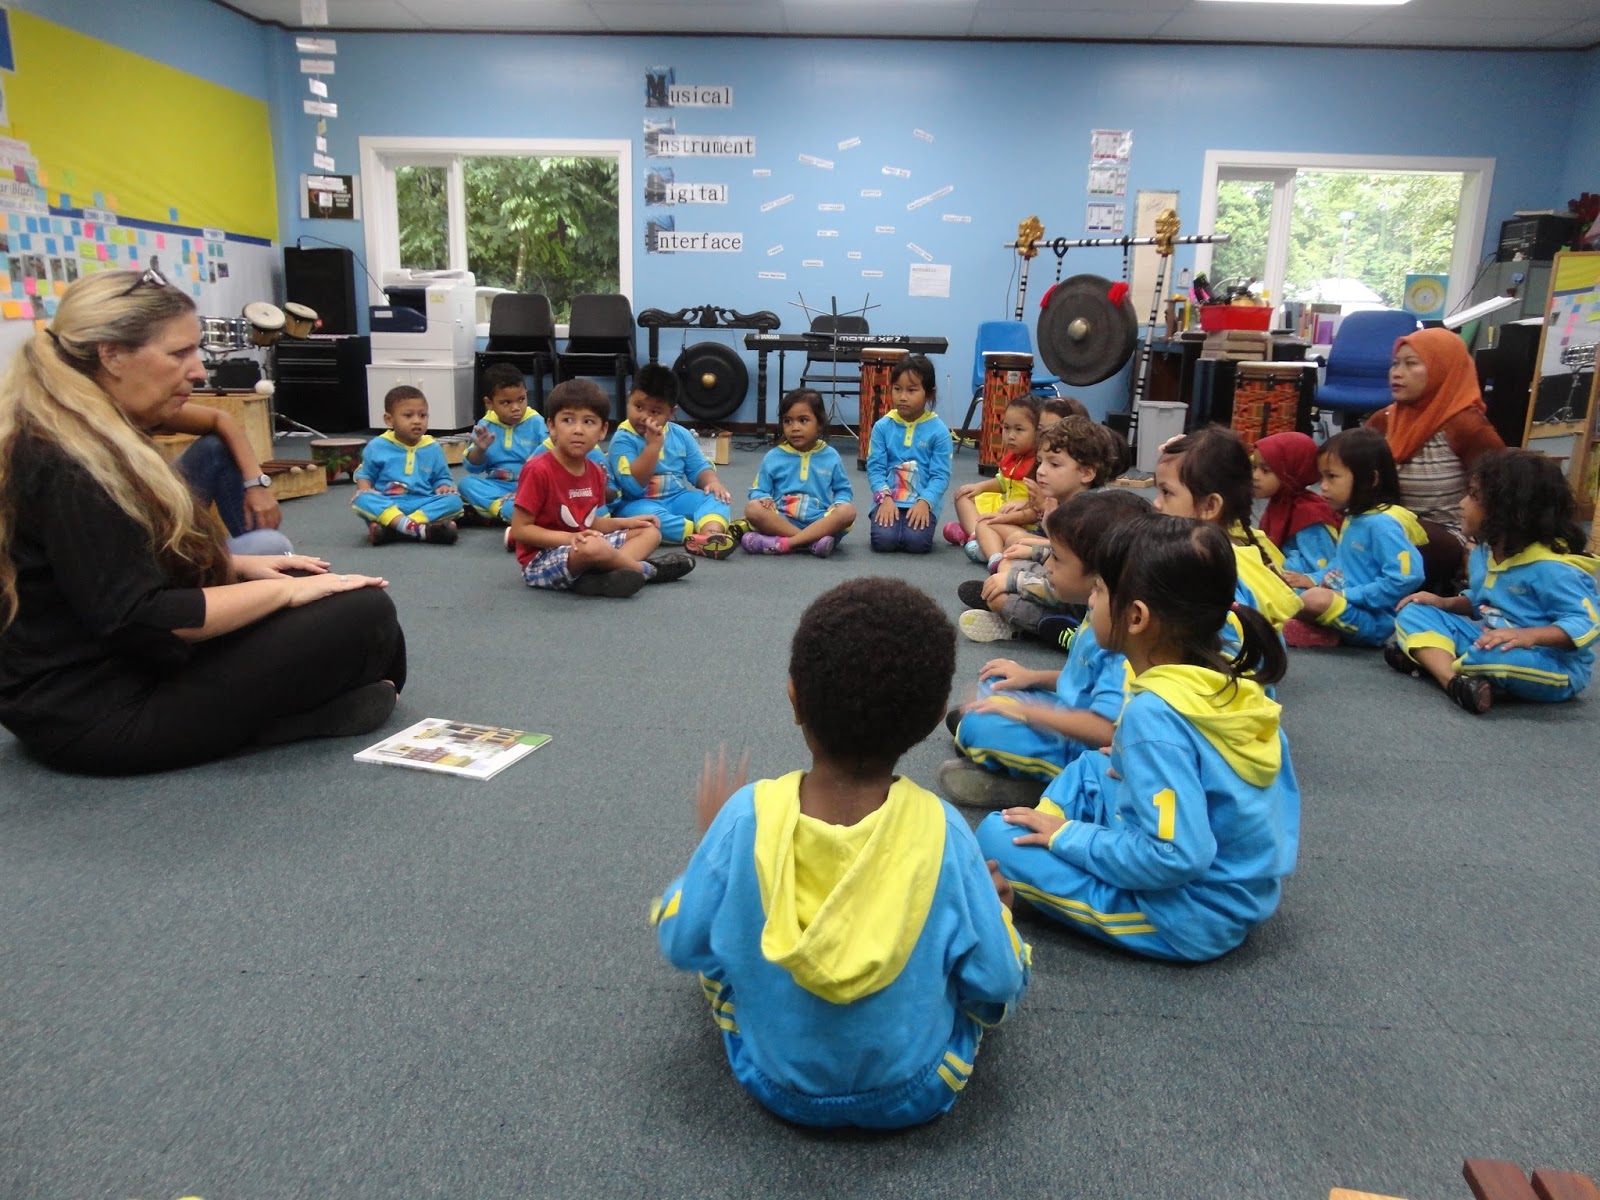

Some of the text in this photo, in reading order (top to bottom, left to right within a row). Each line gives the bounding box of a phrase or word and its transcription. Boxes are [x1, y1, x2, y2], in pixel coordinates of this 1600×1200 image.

[645, 72, 731, 107] Musical
[1397, 550, 1411, 575] 1
[1152, 787, 1176, 840] 1
